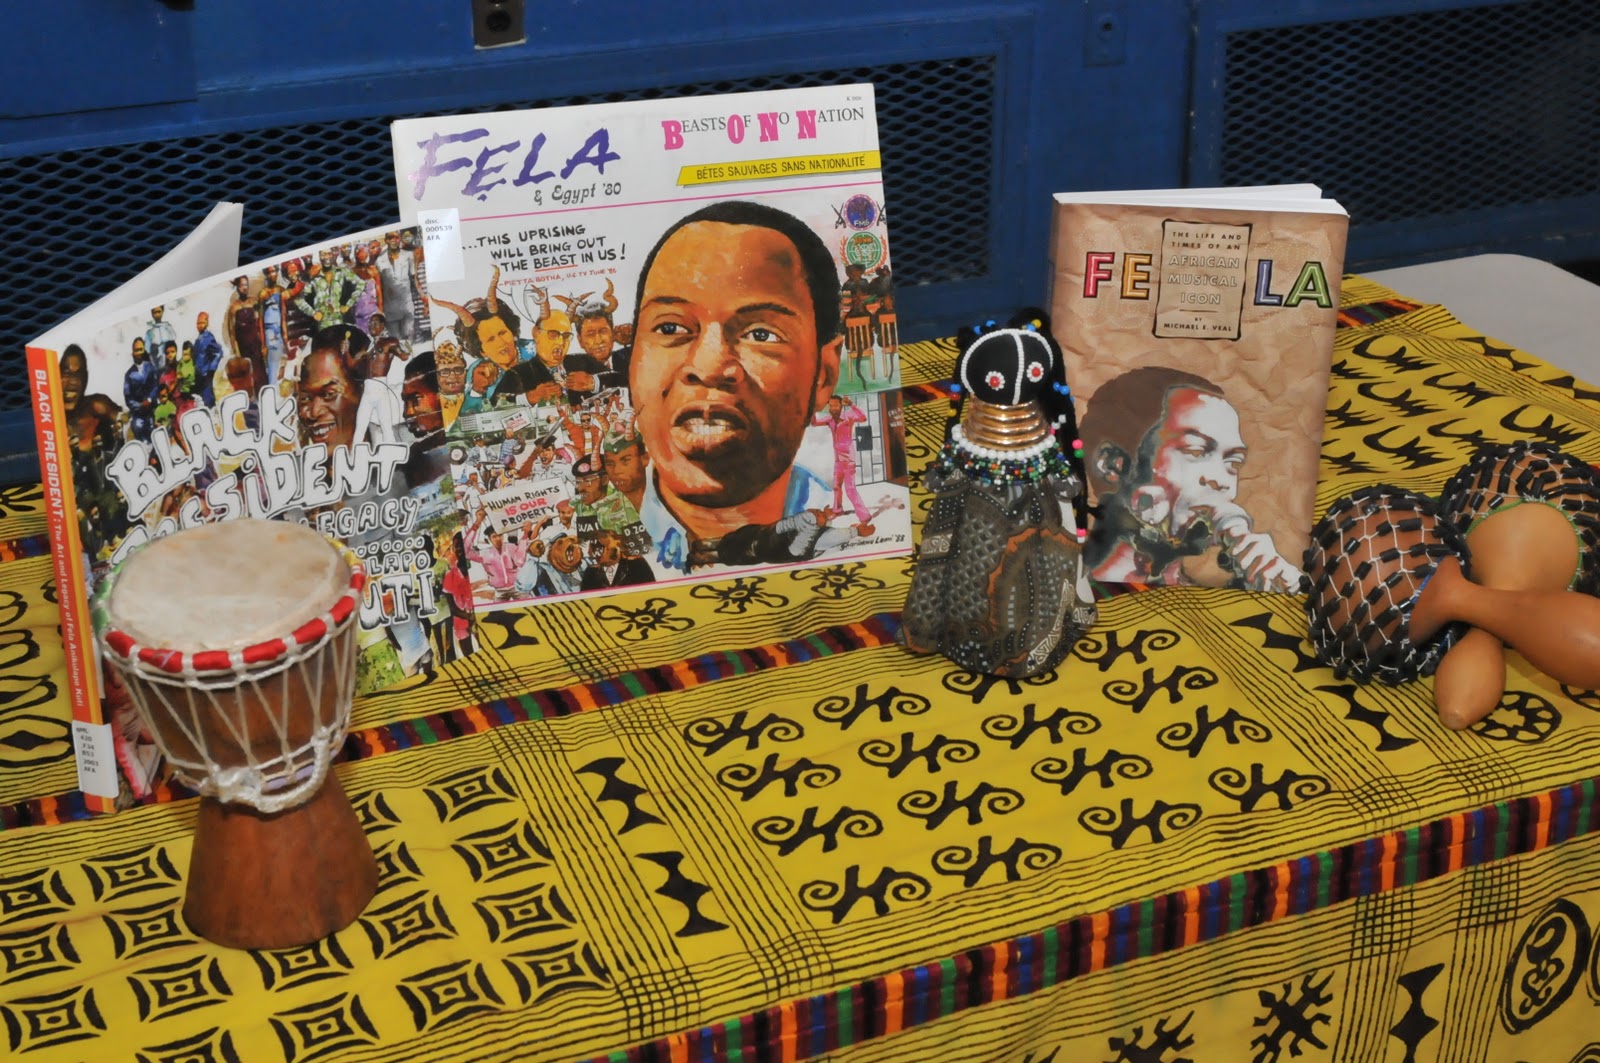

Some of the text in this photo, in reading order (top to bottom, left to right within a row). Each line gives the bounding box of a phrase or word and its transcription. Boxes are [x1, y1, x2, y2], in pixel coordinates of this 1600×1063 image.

[796, 106, 865, 140] NATION
[408, 127, 621, 201] FELA
[727, 162, 778, 177] SAUVAGES
[781, 160, 806, 173] SANS
[533, 189, 543, 206] &
[551, 184, 596, 205] Egypt
[518, 224, 586, 243] UPRISING
[490, 236, 607, 260] WILL BRING OUT
[500, 260, 528, 272] THE
[534, 254, 577, 270] BEAST
[581, 252, 593, 264] IN
[1169, 255, 1240, 269] AFRICAN
[1168, 274, 1238, 288] MUSICAL
[1180, 292, 1221, 305] ICON
[1163, 323, 1199, 331] MICHAEL
[34, 369, 52, 423] BLACK
[106, 386, 298, 521] BLACK
[487, 486, 560, 511] HUMAN RIGHTS
[505, 498, 547, 516] IS OUR
[501, 504, 555, 527] PROPERTY
[54, 525, 63, 541] The
[56, 543, 65, 558] Art
[58, 559, 67, 576] and
[59, 578, 71, 610] Legacy
[66, 623, 76, 641] Fela
[72, 688, 83, 706] Kuti
